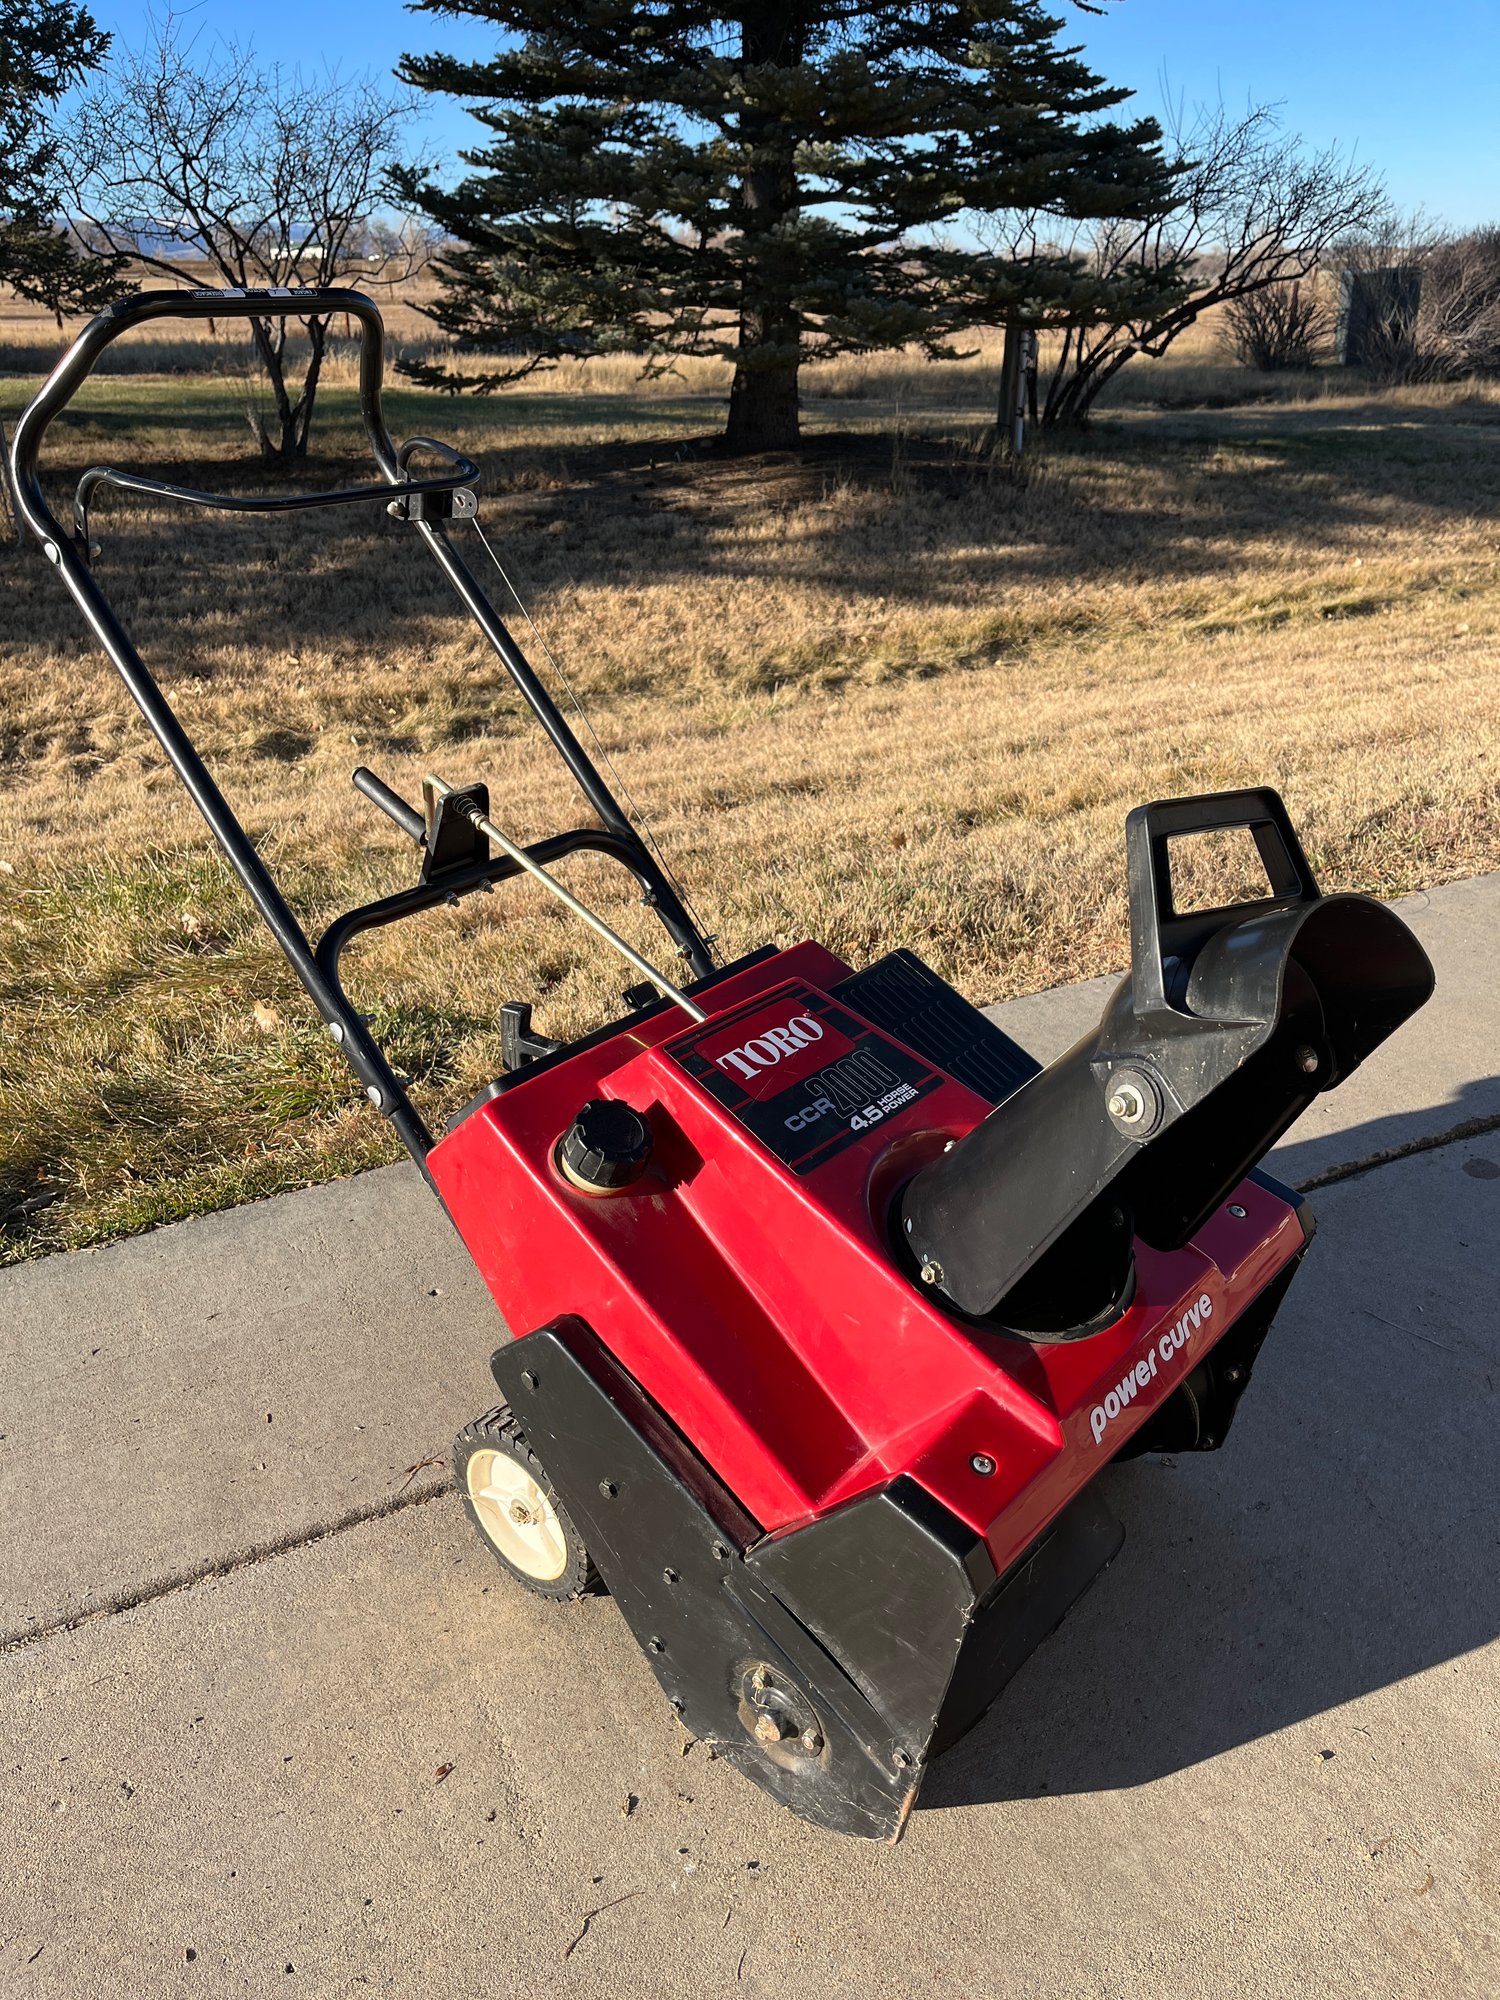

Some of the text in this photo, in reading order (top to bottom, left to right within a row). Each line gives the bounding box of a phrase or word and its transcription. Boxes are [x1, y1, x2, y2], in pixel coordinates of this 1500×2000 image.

[716, 1017, 823, 1080] TORO
[784, 1050, 901, 1132] CCR 2000
[877, 1083, 912, 1107] HORSE
[881, 1088, 919, 1113] POWER
[850, 1105, 884, 1131] 4.5
[1090, 1294, 1213, 1444] power curve
